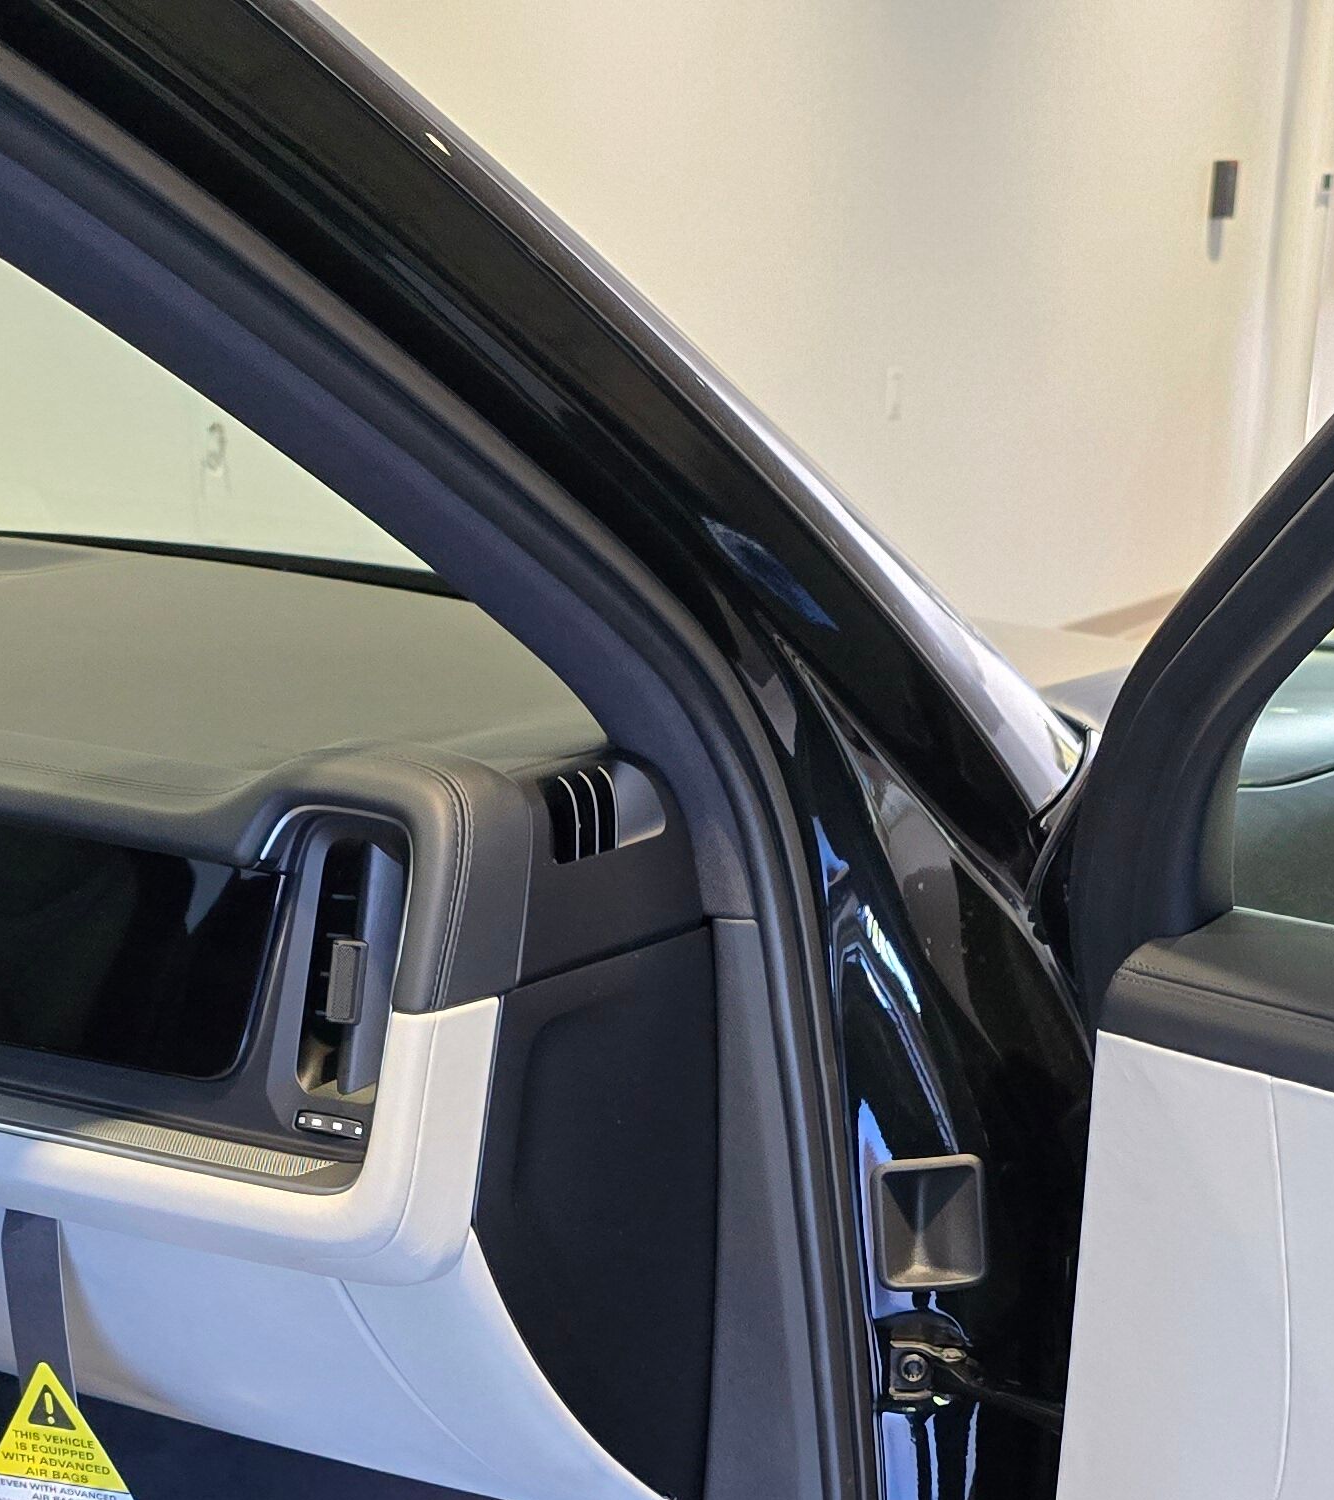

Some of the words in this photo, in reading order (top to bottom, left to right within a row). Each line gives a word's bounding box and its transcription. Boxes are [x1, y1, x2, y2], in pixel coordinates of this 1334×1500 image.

[13, 1430, 40, 1440] THIS
[43, 1433, 95, 1449] VEHICLE
[15, 1442, 27, 1450] IS
[32, 1444, 94, 1461] EQUIPPED
[2, 1451, 35, 1463] WITH
[40, 1457, 110, 1475] ADVANCED
[26, 1467, 47, 1477] AIR
[52, 1471, 88, 1484] BAGS
[0, 1477, 27, 1488] EVEN
[28, 1482, 56, 1493] WITH
[31, 1492, 50, 1500] AIR
